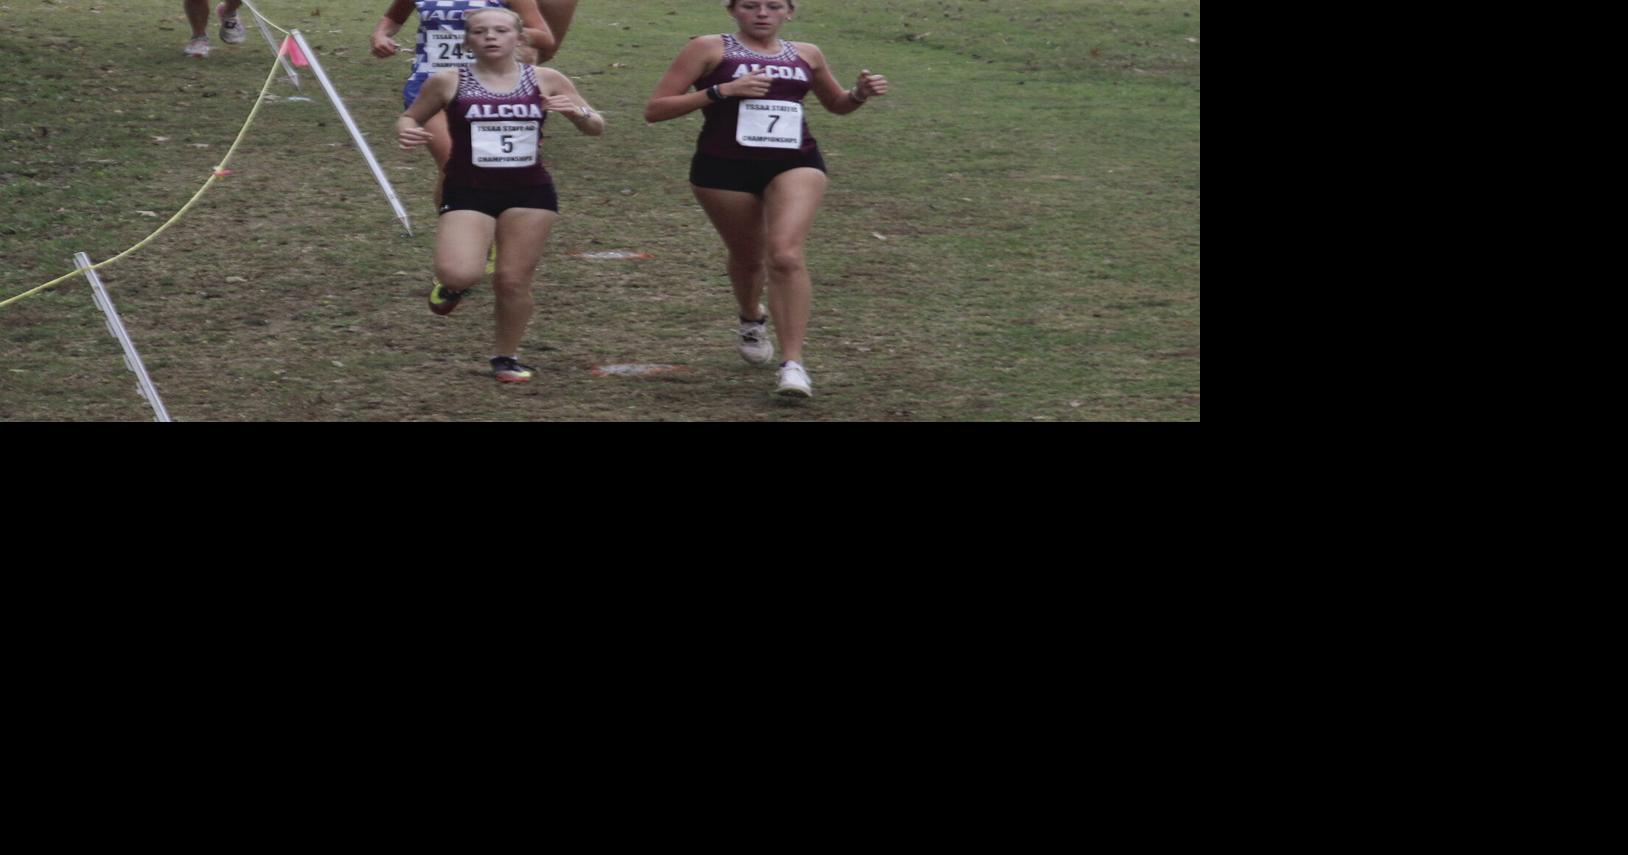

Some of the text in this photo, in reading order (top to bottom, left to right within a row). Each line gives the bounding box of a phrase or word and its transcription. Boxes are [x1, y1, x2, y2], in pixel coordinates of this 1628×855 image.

[418, 10, 465, 20] MAC
[465, 104, 542, 118] ALCOA
[767, 114, 780, 133] 7
[501, 135, 513, 153] 5
[742, 135, 798, 143] CHAMPIONSHIPS
